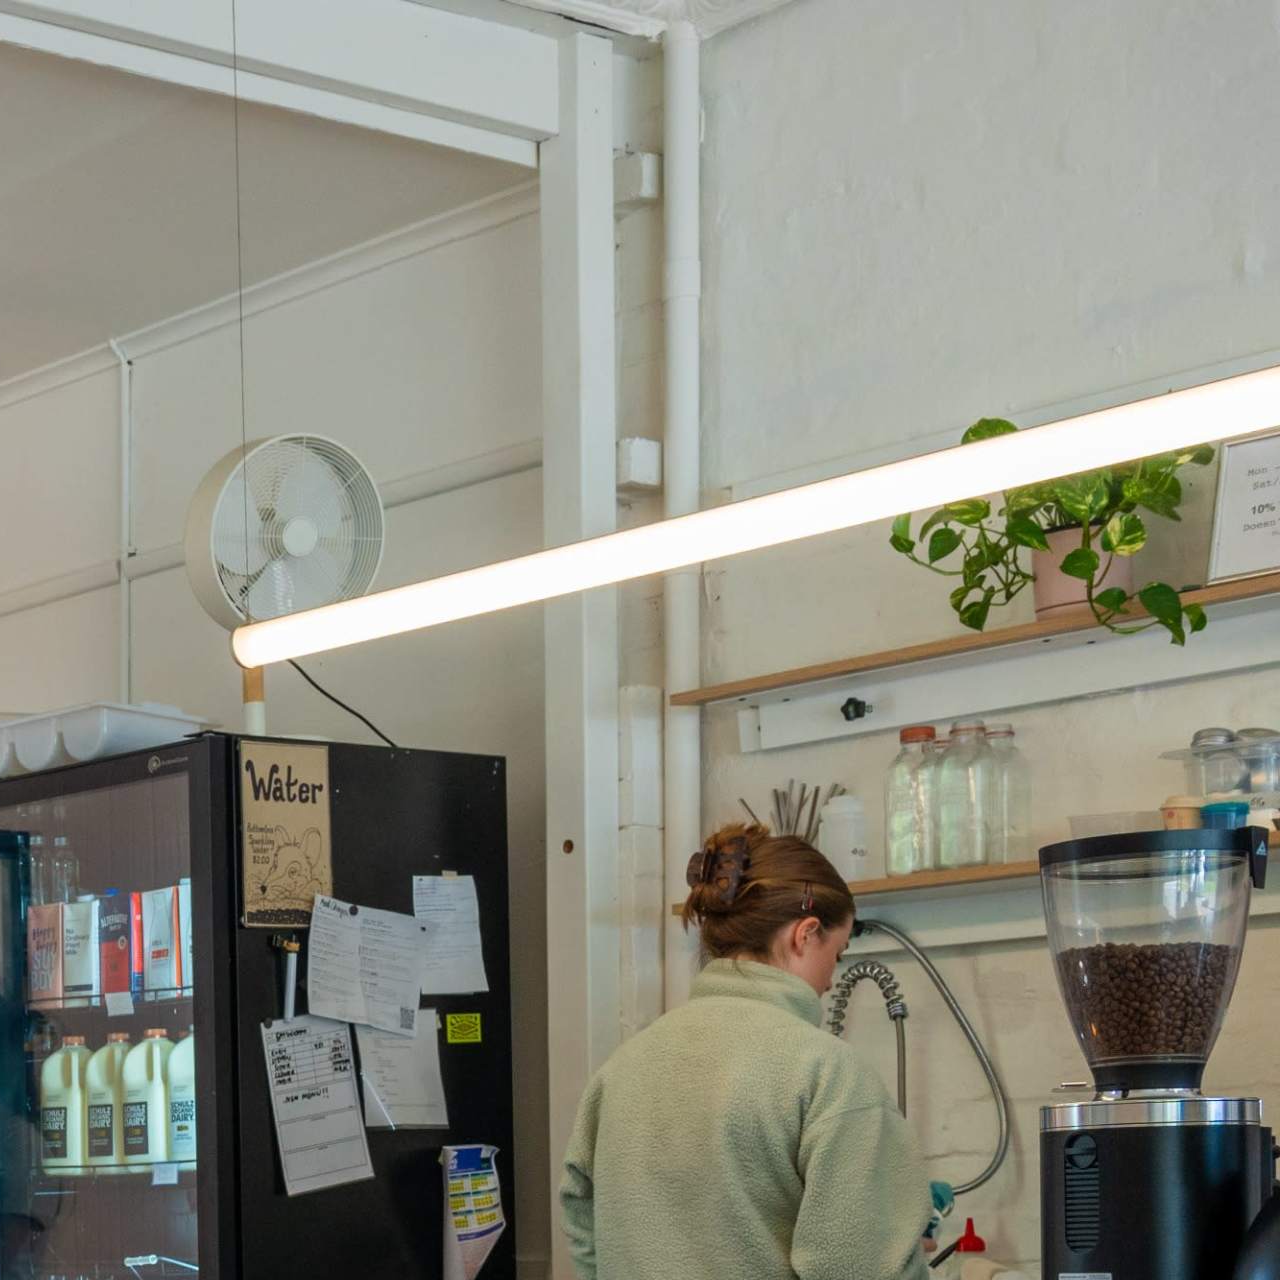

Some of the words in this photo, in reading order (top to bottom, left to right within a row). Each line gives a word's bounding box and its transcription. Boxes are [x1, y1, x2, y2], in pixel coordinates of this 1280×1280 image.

[1251, 502, 1276, 515] 10%
[245, 759, 324, 804] Water
[31, 970, 54, 992] BOY
[171, 1100, 195, 1109] SCHULZ
